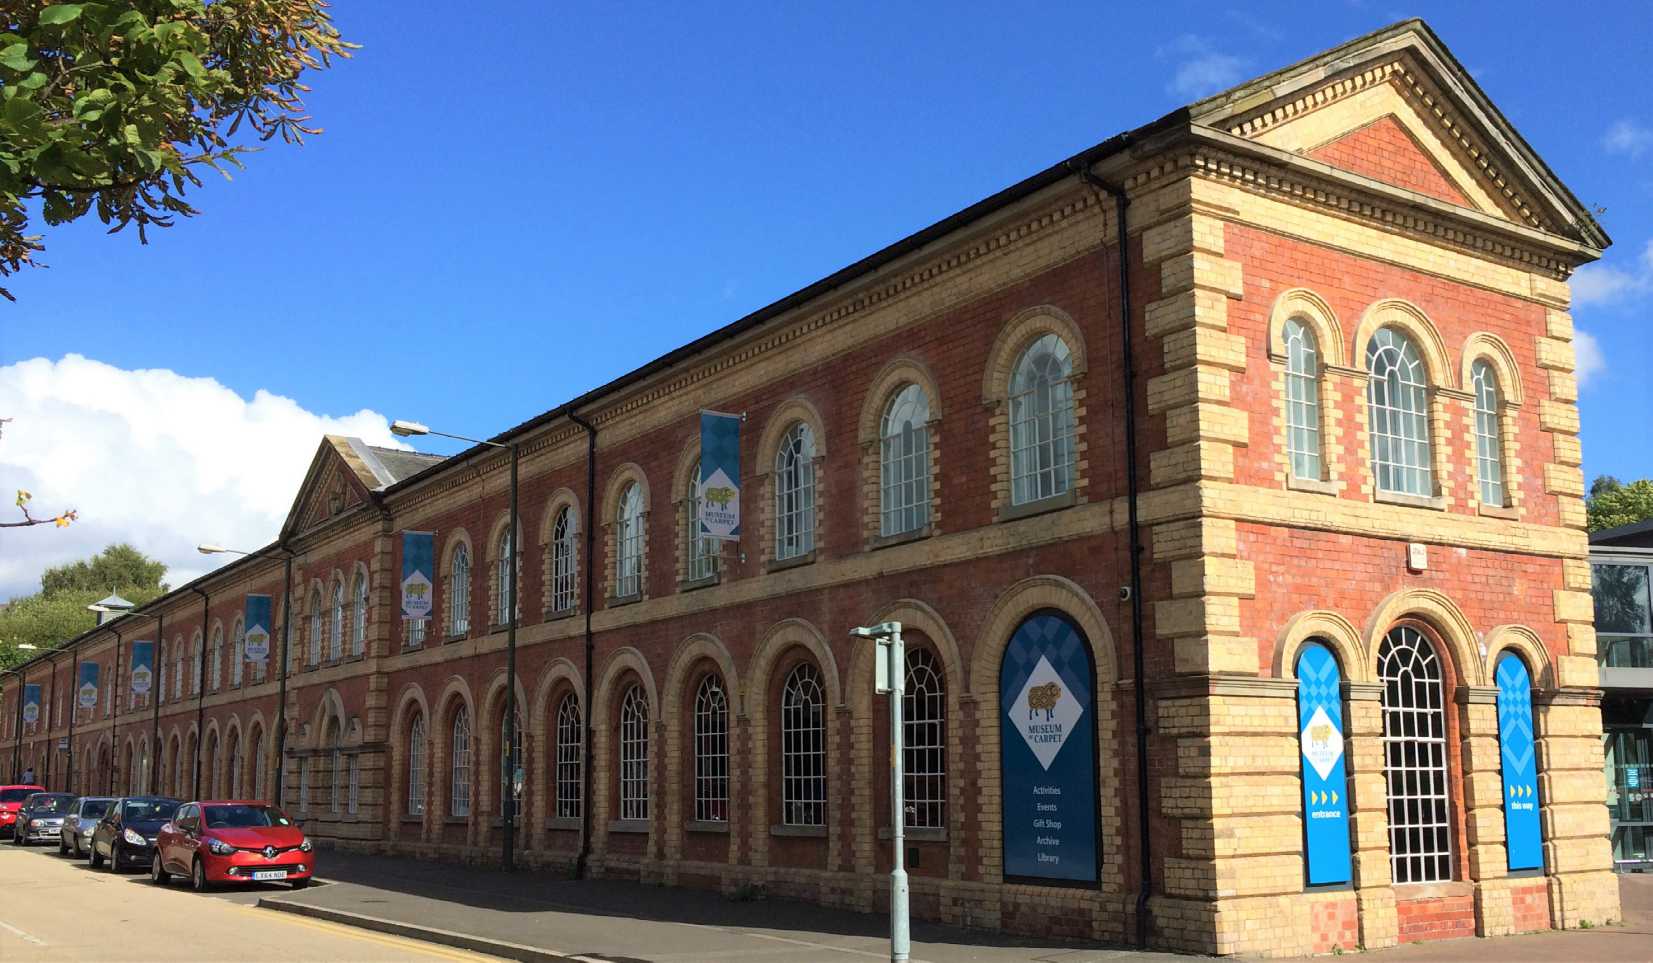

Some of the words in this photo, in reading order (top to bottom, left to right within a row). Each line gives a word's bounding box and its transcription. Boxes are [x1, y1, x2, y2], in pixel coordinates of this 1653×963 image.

[1028, 724, 1062, 734] MUSEUM
[1034, 734, 1063, 743] CARPET
[1033, 785, 1061, 795] Activities
[1037, 802, 1057, 811] Events
[1311, 810, 1341, 819] entrance
[1033, 819, 1045, 829] Gift
[1046, 819, 1062, 831] Shop
[1037, 836, 1060, 846] Archive
[1037, 853, 1060, 864] Library
